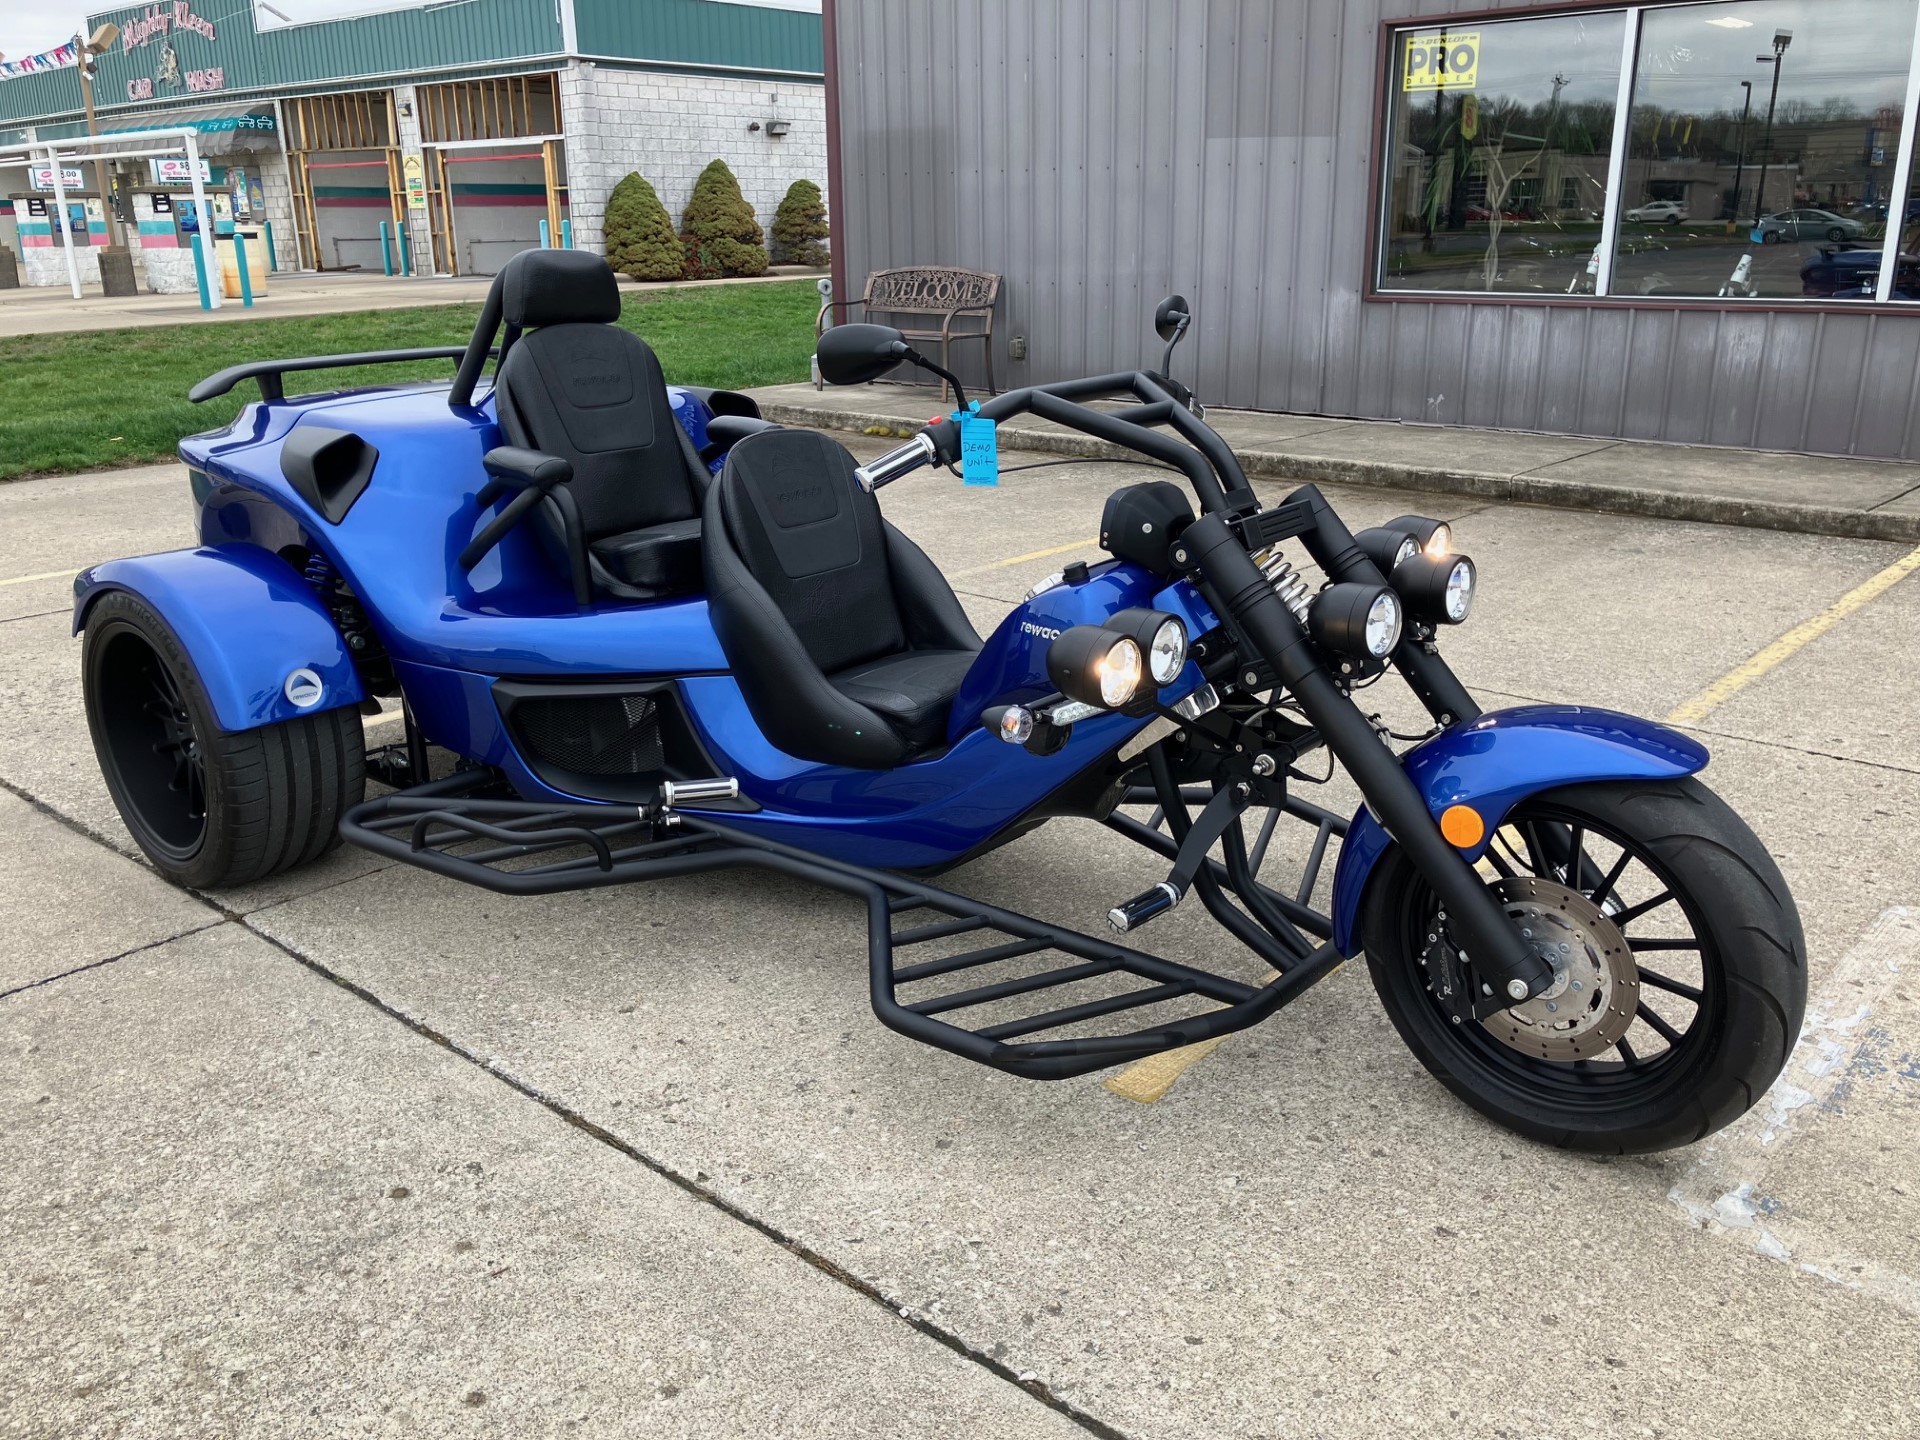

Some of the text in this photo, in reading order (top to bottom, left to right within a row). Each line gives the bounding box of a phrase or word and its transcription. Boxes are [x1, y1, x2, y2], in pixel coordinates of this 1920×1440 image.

[1426, 36, 1468, 45] DUNLOP
[1408, 44, 1475, 76] PRO
[127, 67, 224, 100] CAR WASH
[1406, 74, 1473, 84] DEALER
[884, 281, 982, 300] WELCOME
[963, 441, 991, 452] DEMO
[1020, 621, 1060, 641] rewac
